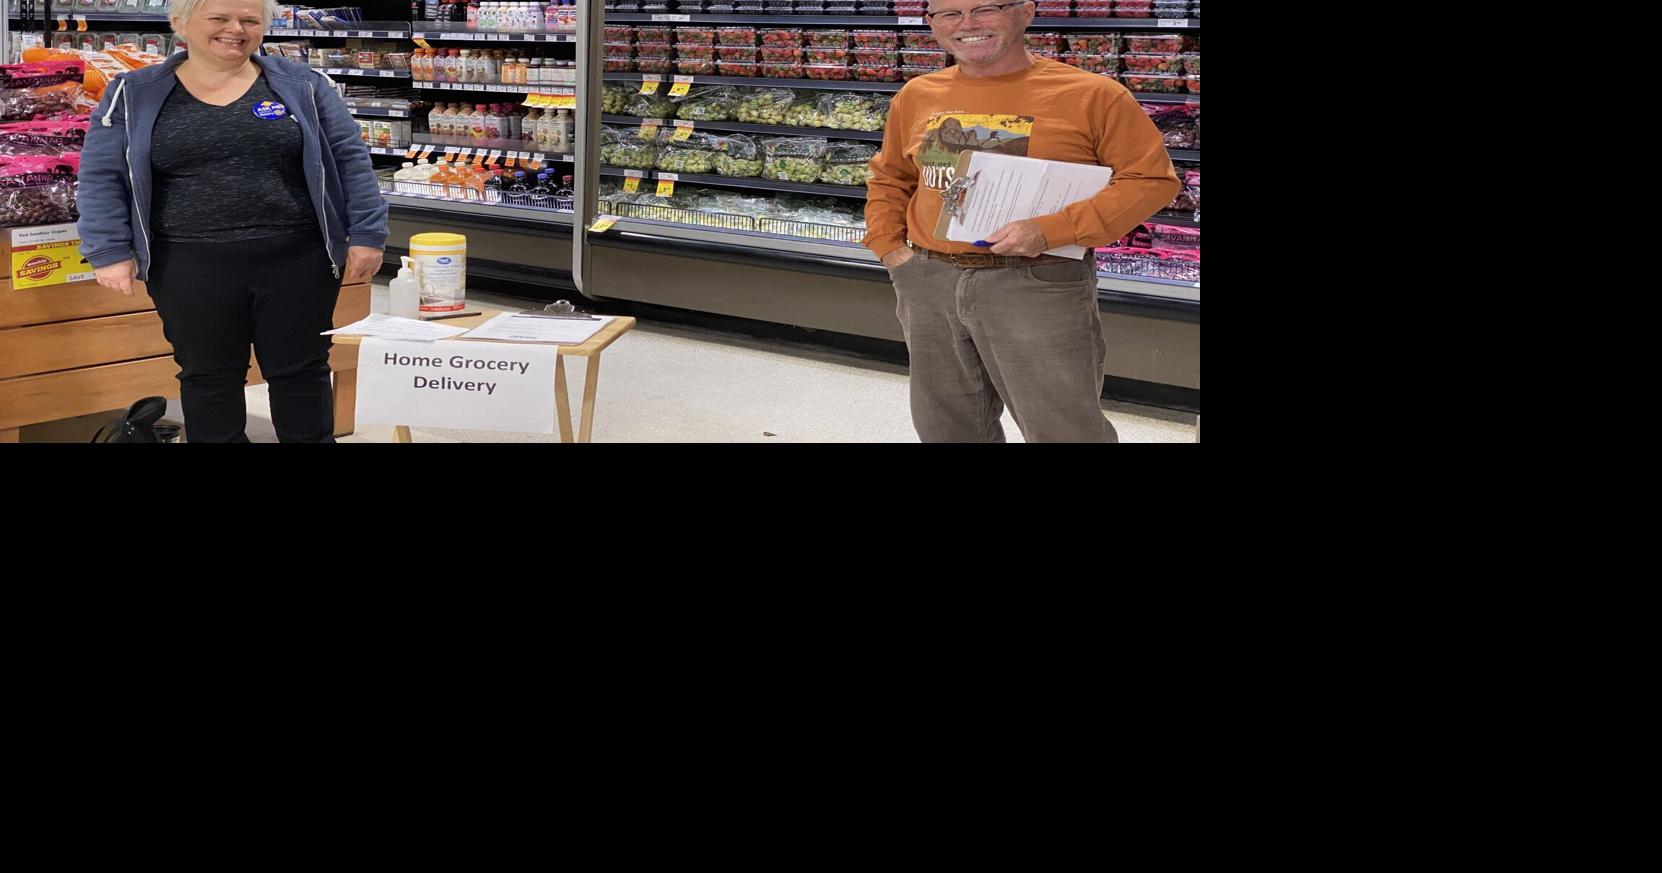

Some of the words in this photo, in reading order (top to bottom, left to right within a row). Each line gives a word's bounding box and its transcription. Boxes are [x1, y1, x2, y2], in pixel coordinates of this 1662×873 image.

[36, 241, 70, 250] SAVINGS
[19, 262, 59, 277] SAVINGS
[384, 352, 443, 368] Home
[450, 355, 530, 375] Grocery
[413, 376, 497, 395] Delivery
